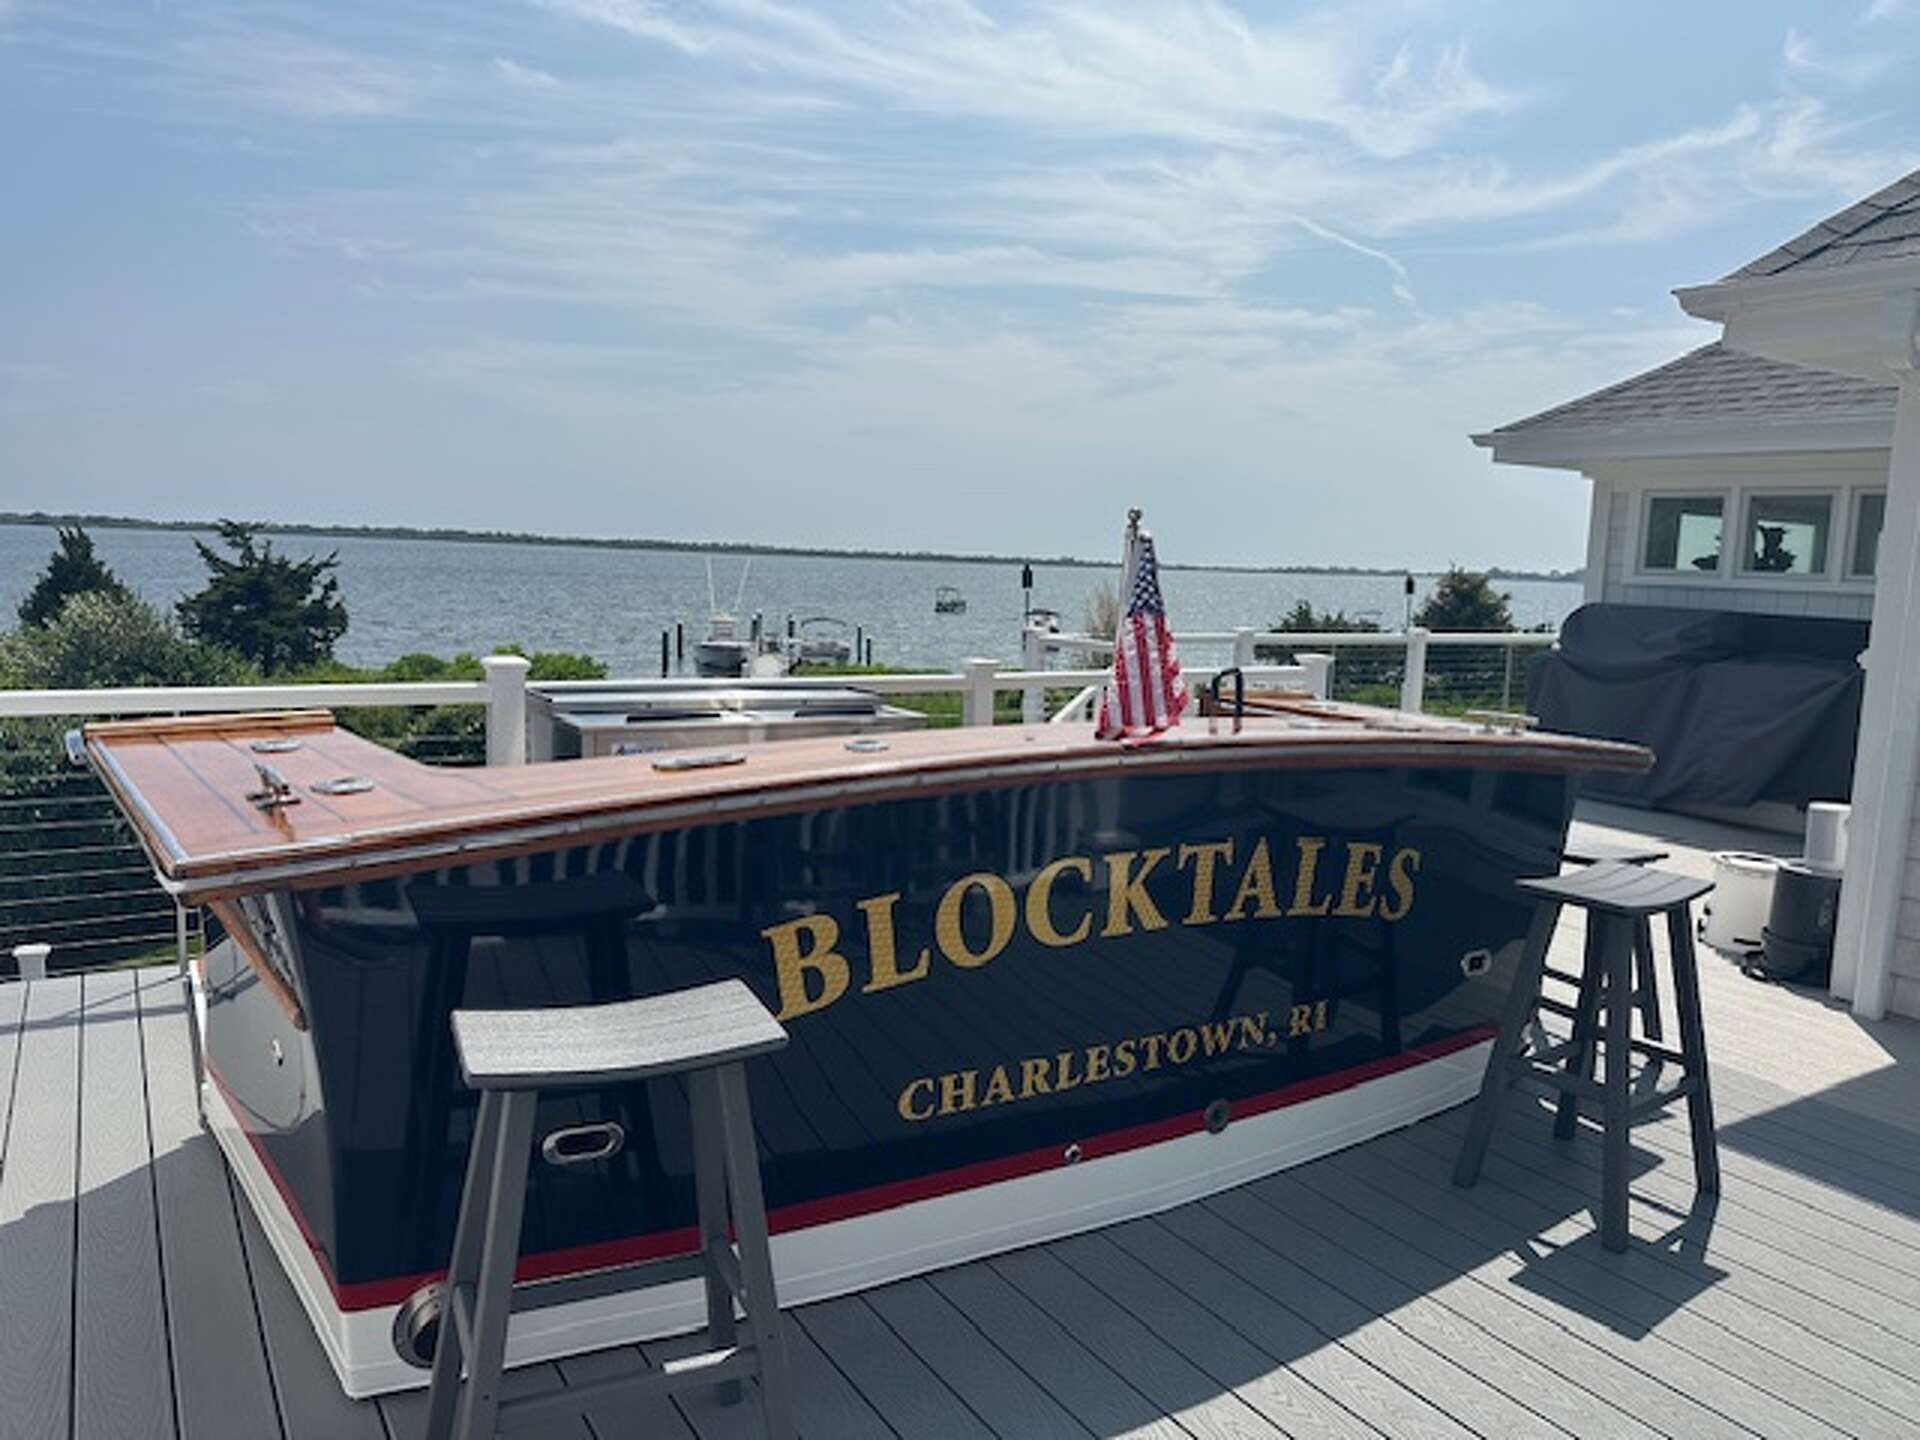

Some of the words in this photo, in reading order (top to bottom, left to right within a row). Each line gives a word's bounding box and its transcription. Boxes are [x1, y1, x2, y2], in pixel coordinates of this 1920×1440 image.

[761, 836, 1422, 1021] BLOCKTALES
[898, 1010, 1278, 1122] CHARLESTOWN,
[1289, 999, 1329, 1036] RI
